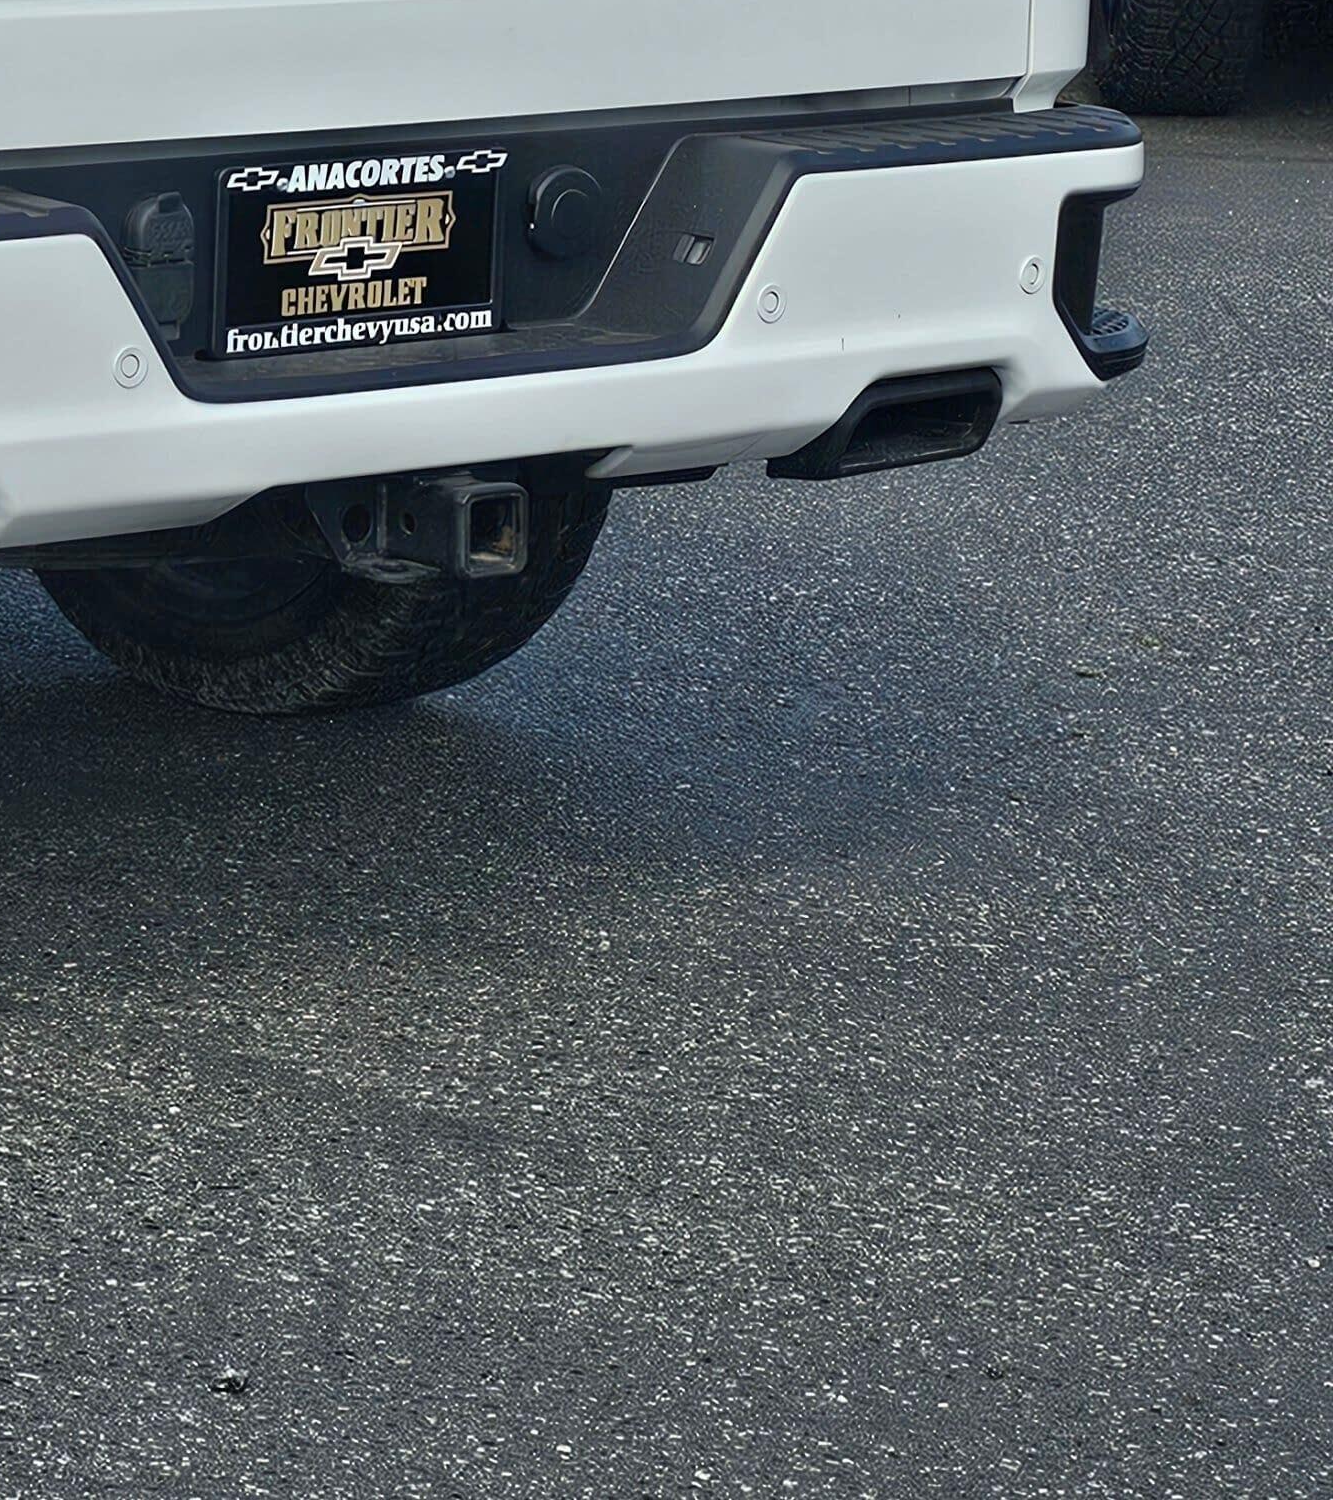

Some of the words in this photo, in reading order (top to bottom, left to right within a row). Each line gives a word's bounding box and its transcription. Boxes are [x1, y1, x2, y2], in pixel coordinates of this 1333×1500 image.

[286, 154, 446, 193] ANACORTES
[270, 197, 450, 257] FRONTIER
[280, 276, 428, 317] CHEVROLET
[225, 309, 493, 354] frontierchevyusa.com
